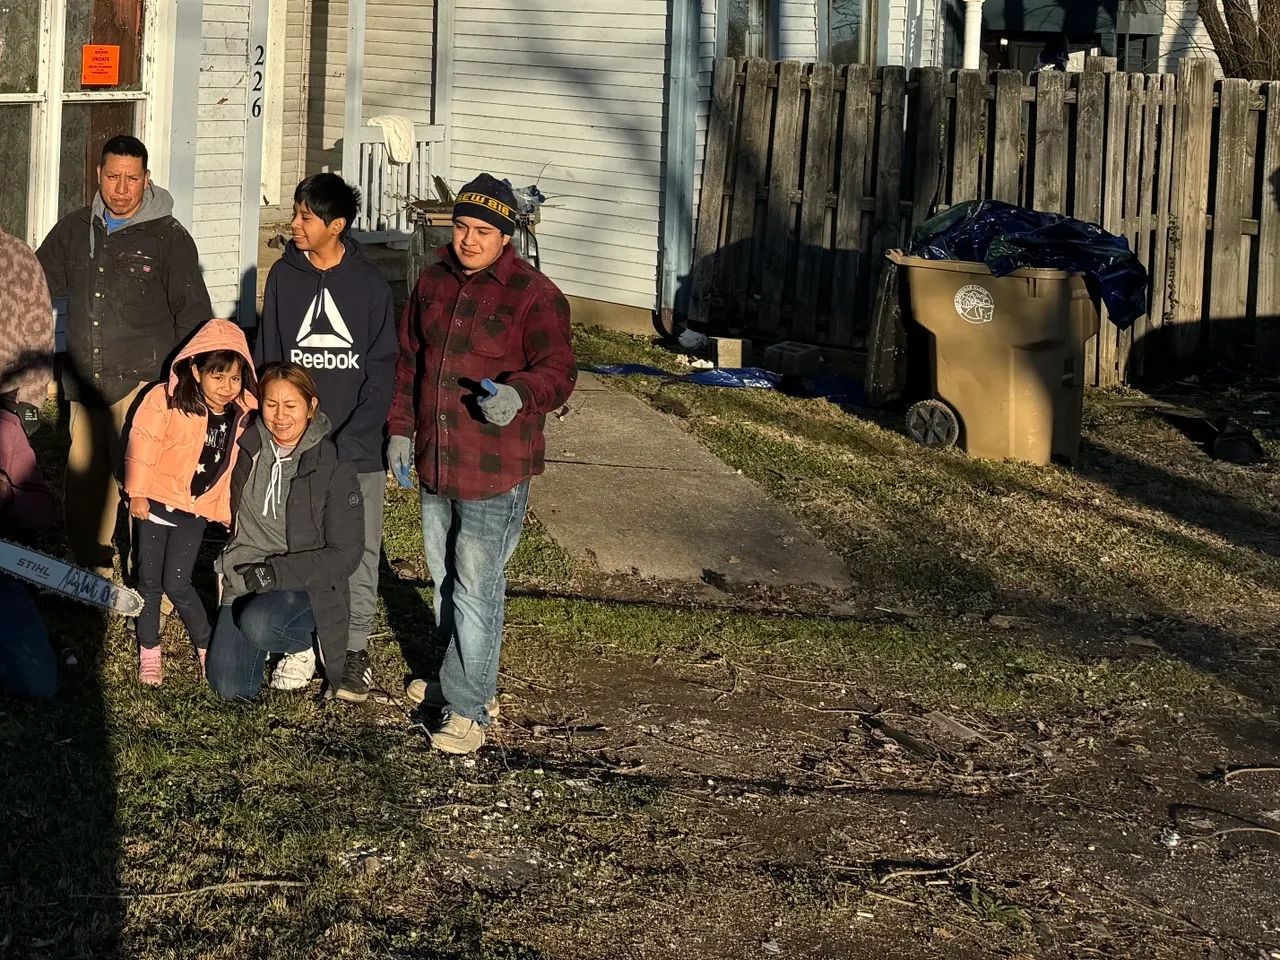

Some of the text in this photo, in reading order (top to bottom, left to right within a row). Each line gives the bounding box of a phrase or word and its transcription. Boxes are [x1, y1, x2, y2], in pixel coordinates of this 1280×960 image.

[251, 44, 265, 118] 226
[290, 349, 360, 370] Reebok
[16, 558, 50, 577] STIHL
